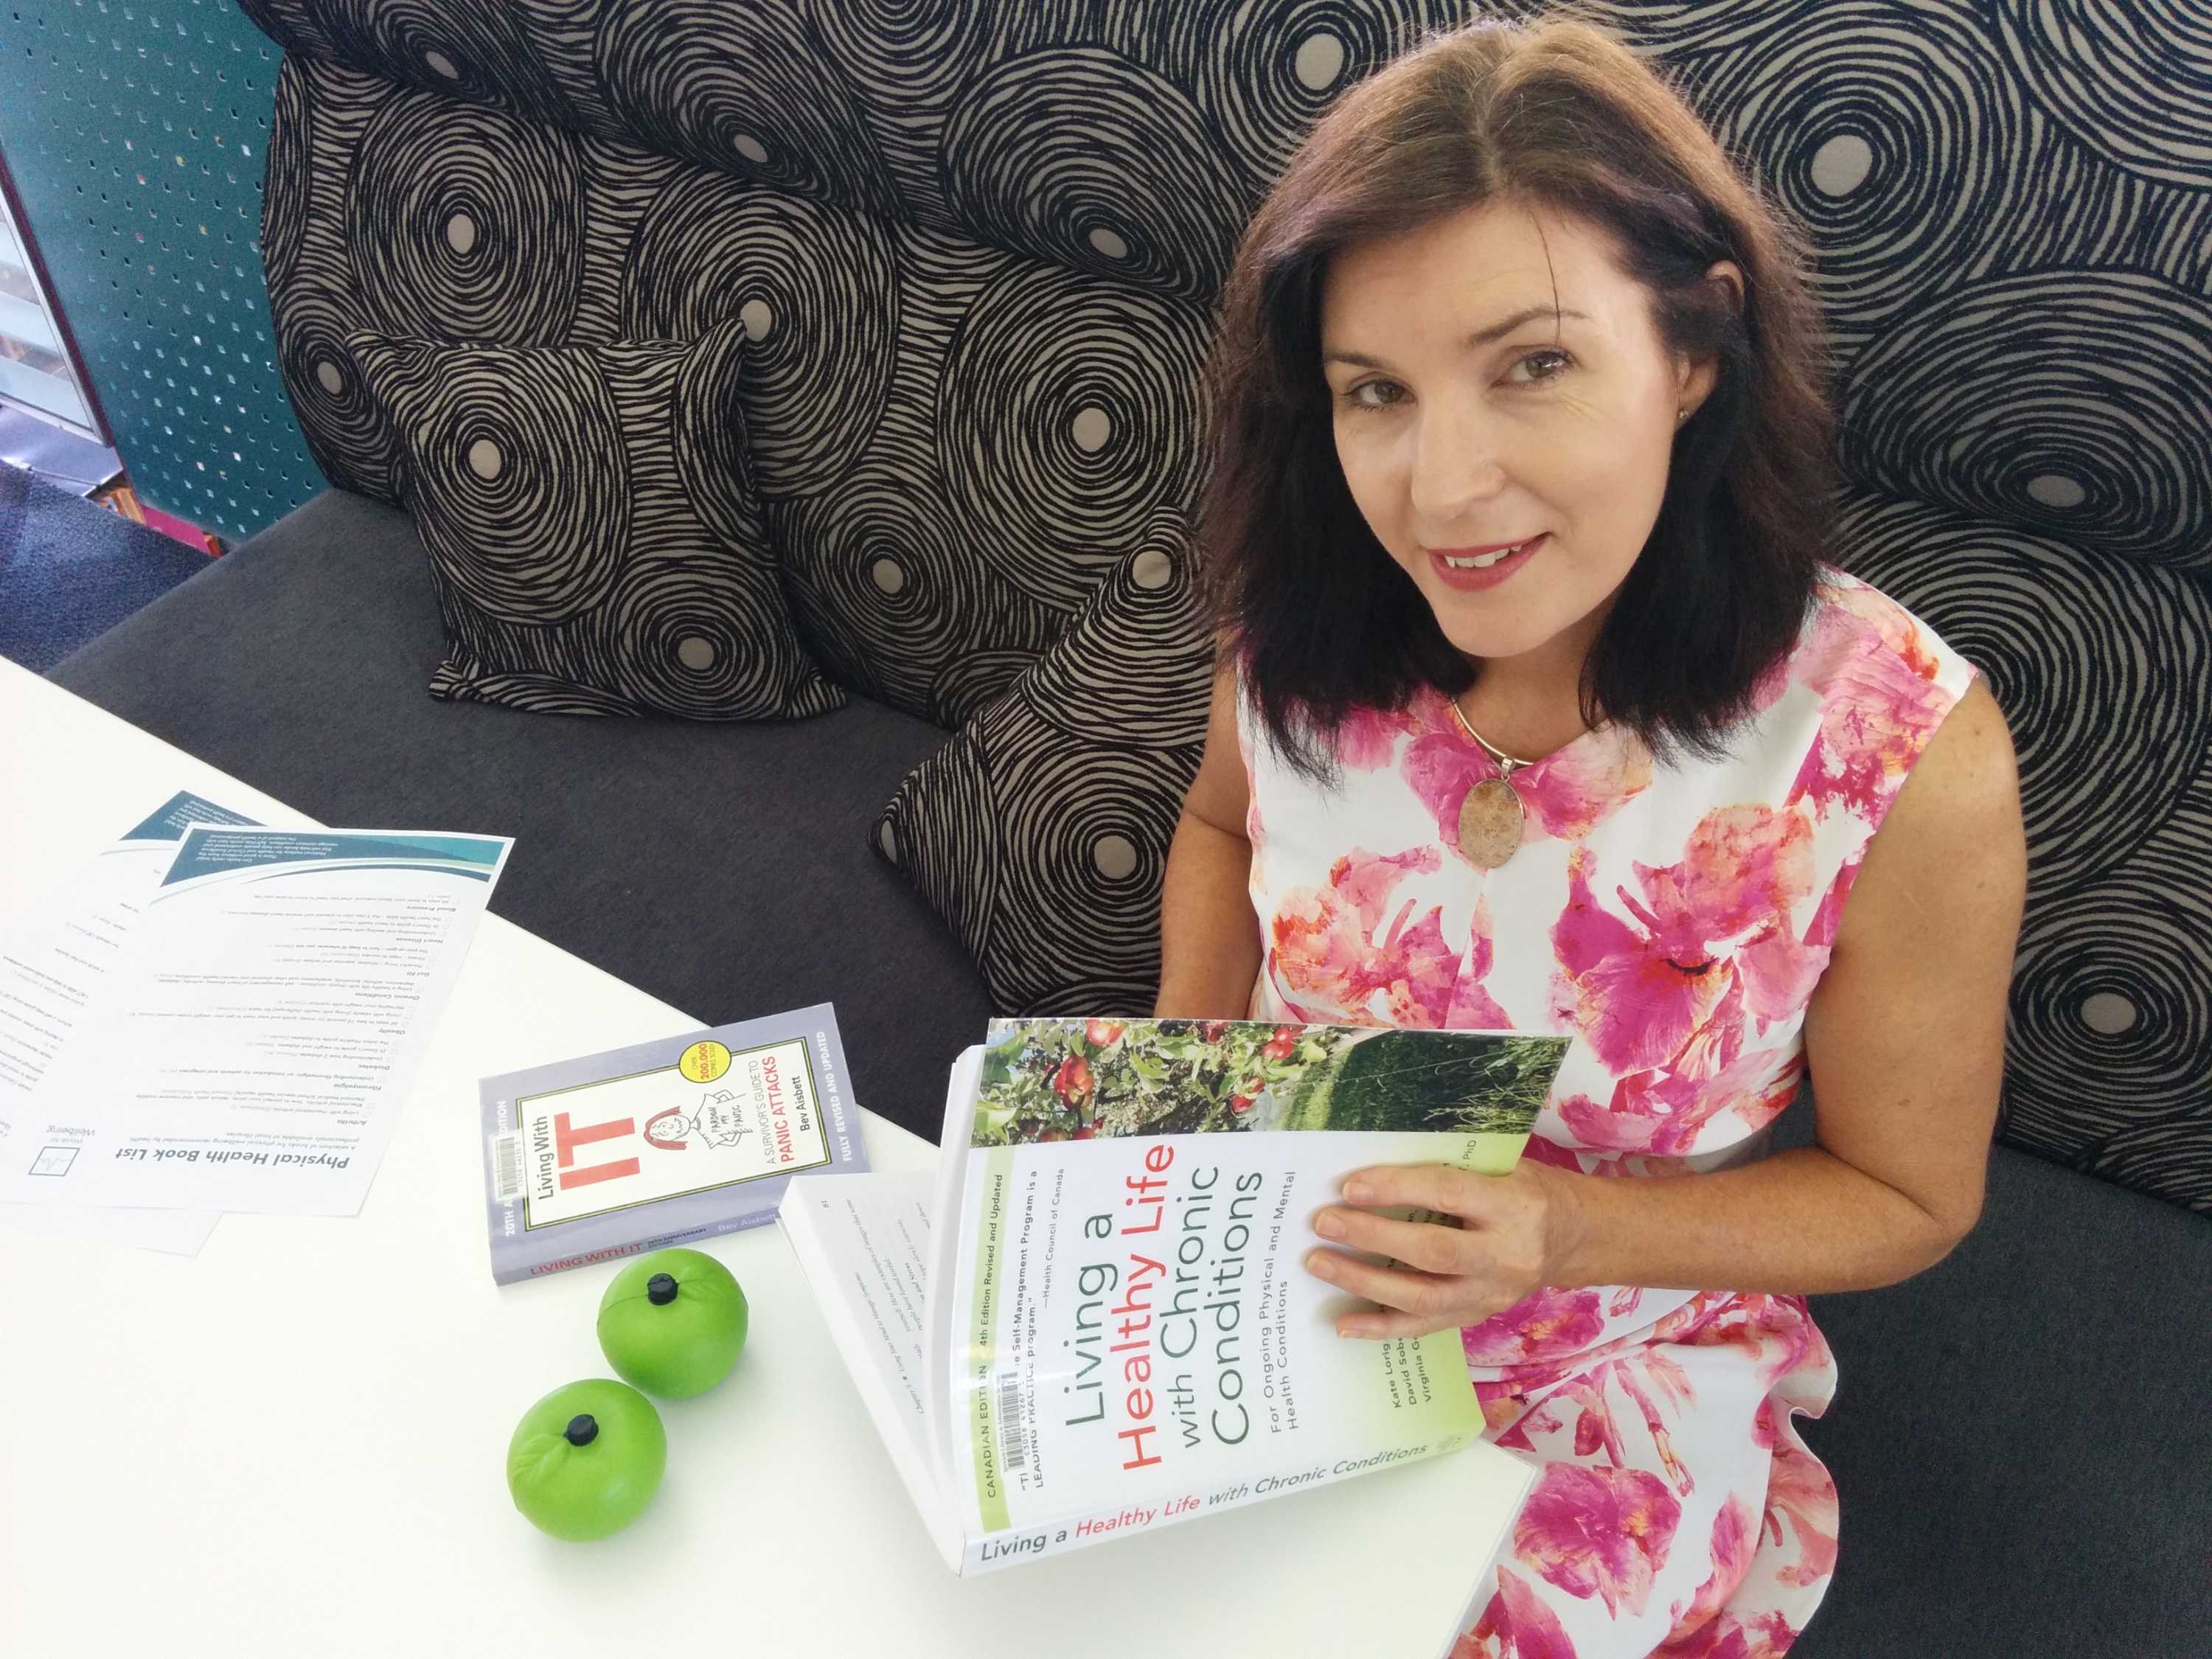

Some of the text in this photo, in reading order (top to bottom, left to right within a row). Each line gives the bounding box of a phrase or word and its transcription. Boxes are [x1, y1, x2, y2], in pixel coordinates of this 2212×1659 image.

[748, 1060, 759, 1072] TO
[750, 1074, 765, 1101] GUIDE
[791, 1075, 810, 1131] Bev Aisbett
[816, 1031, 852, 1161] FULLY REVISED AND UPDATED
[707, 1106, 720, 1133] PARDON
[720, 1114, 729, 1124] MY
[731, 1105, 743, 1127] PANIC
[762, 1056, 795, 1162] PANIC ATTACKS
[115, 1148, 349, 1169] Physical Health Book List
[532, 1116, 554, 1200] Living With
[554, 1112, 640, 1190] IT
[990, 1174, 1003, 1218] Updated
[1026, 1181, 1036, 1190] is
[1051, 1168, 1064, 1205] Canada
[504, 1211, 515, 1237] 20TH
[717, 1223, 737, 1232] Bev
[988, 1222, 998, 1241] and
[1020, 1194, 1034, 1243] Program
[1050, 1209, 1058, 1219] of
[530, 1242, 641, 1276] LIVING WITH IT
[1045, 1222, 1057, 1260] Council
[984, 1245, 995, 1284] Revised
[980, 1288, 992, 1325] Edition
[1011, 1248, 1028, 1352] Self-Management
[1110, 1144, 1175, 1470] Healthy Life
[1158, 1166, 1219, 1448] with Chronic
[1203, 1172, 1262, 1444] Conditions
[1258, 1171, 1295, 1433] For Ongoing Physical and Mental
[979, 1329, 988, 1347] 4th
[1062, 1213, 1119, 1426] Living a
[1276, 1280, 1299, 1429] Health Conditions
[1389, 1380, 1402, 1408] Kate
[1401, 1369, 1417, 1405] David
[1416, 1354, 1432, 1402] Virginia
[980, 1425, 996, 1498] CANADIAN
[980, 1441, 1427, 1562] Living a Healthy Life with Chronic Conditions
